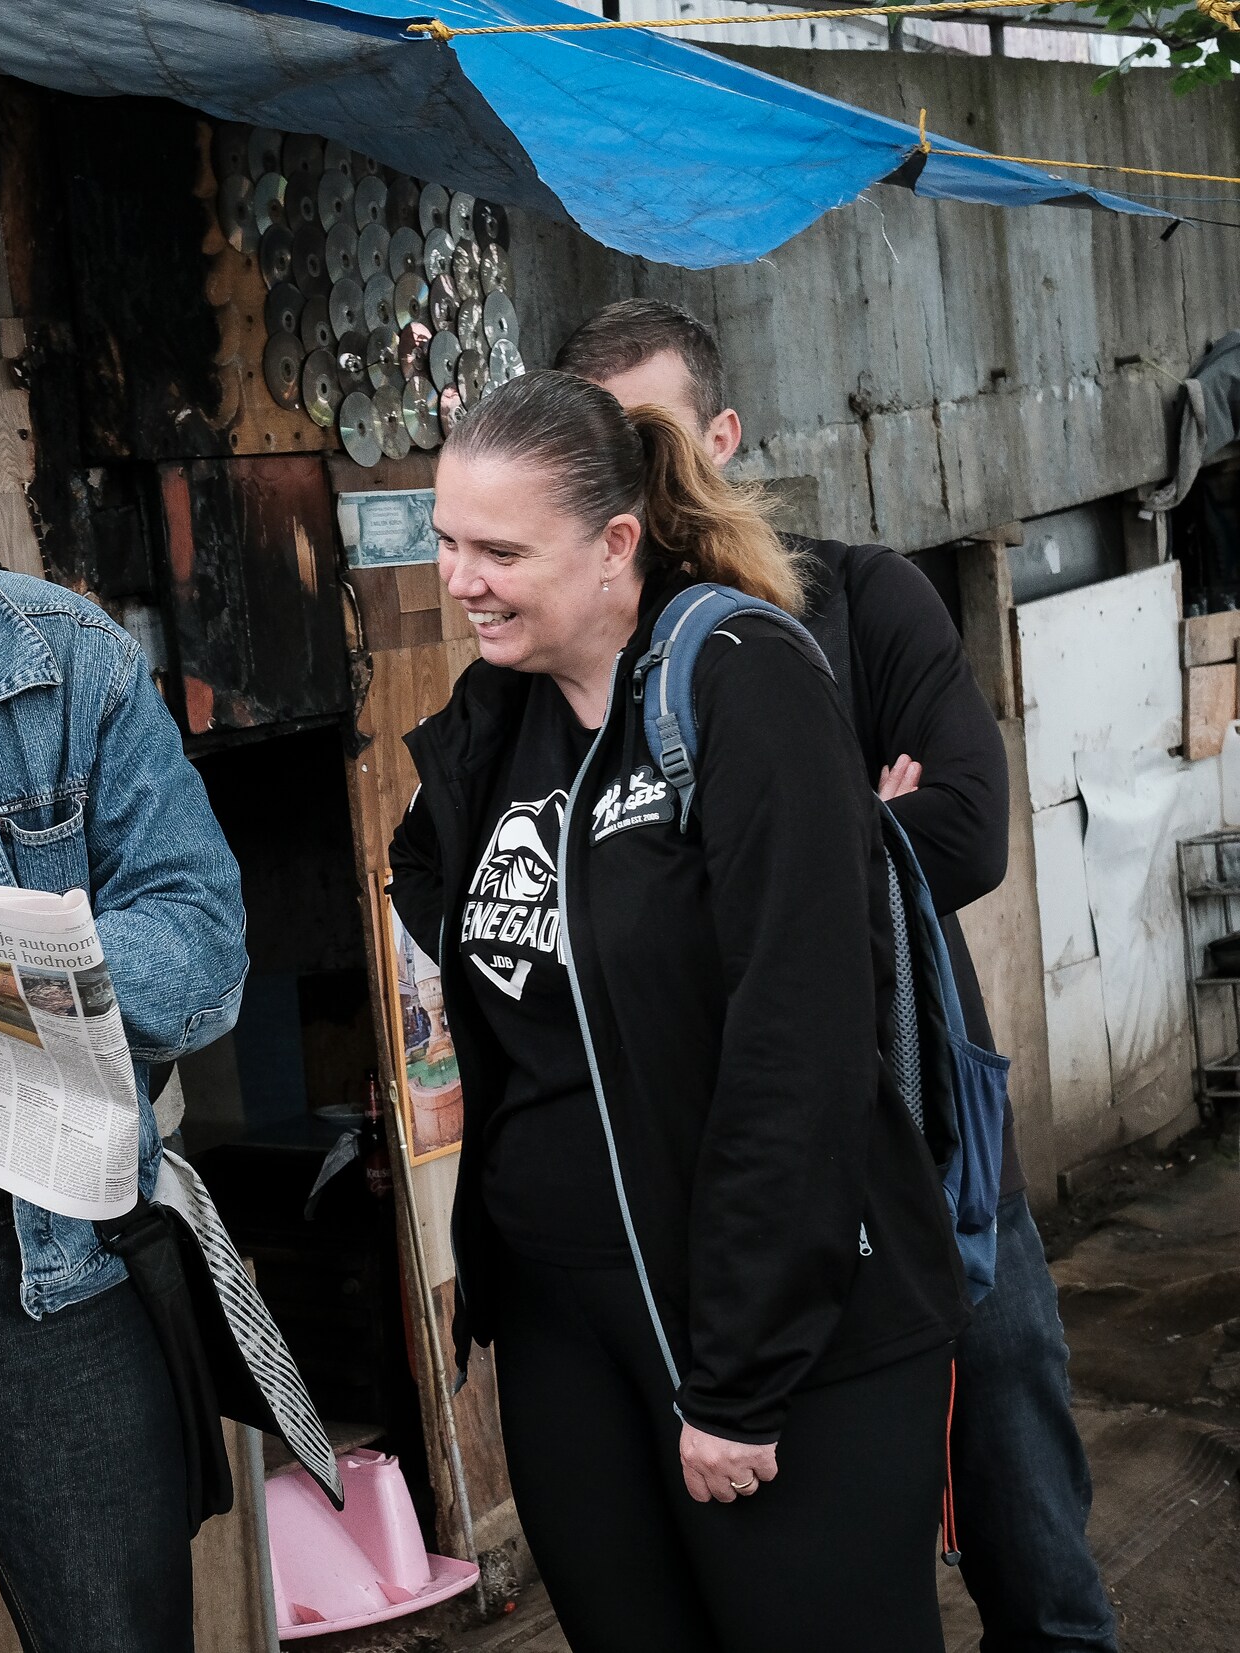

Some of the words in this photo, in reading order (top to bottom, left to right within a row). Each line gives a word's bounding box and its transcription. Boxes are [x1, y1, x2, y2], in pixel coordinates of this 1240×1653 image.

[19, 932, 96, 953] autonom
[460, 901, 568, 965] ENEGAD
[21, 950, 94, 968] hodnota
[490, 955, 514, 969] JDB
